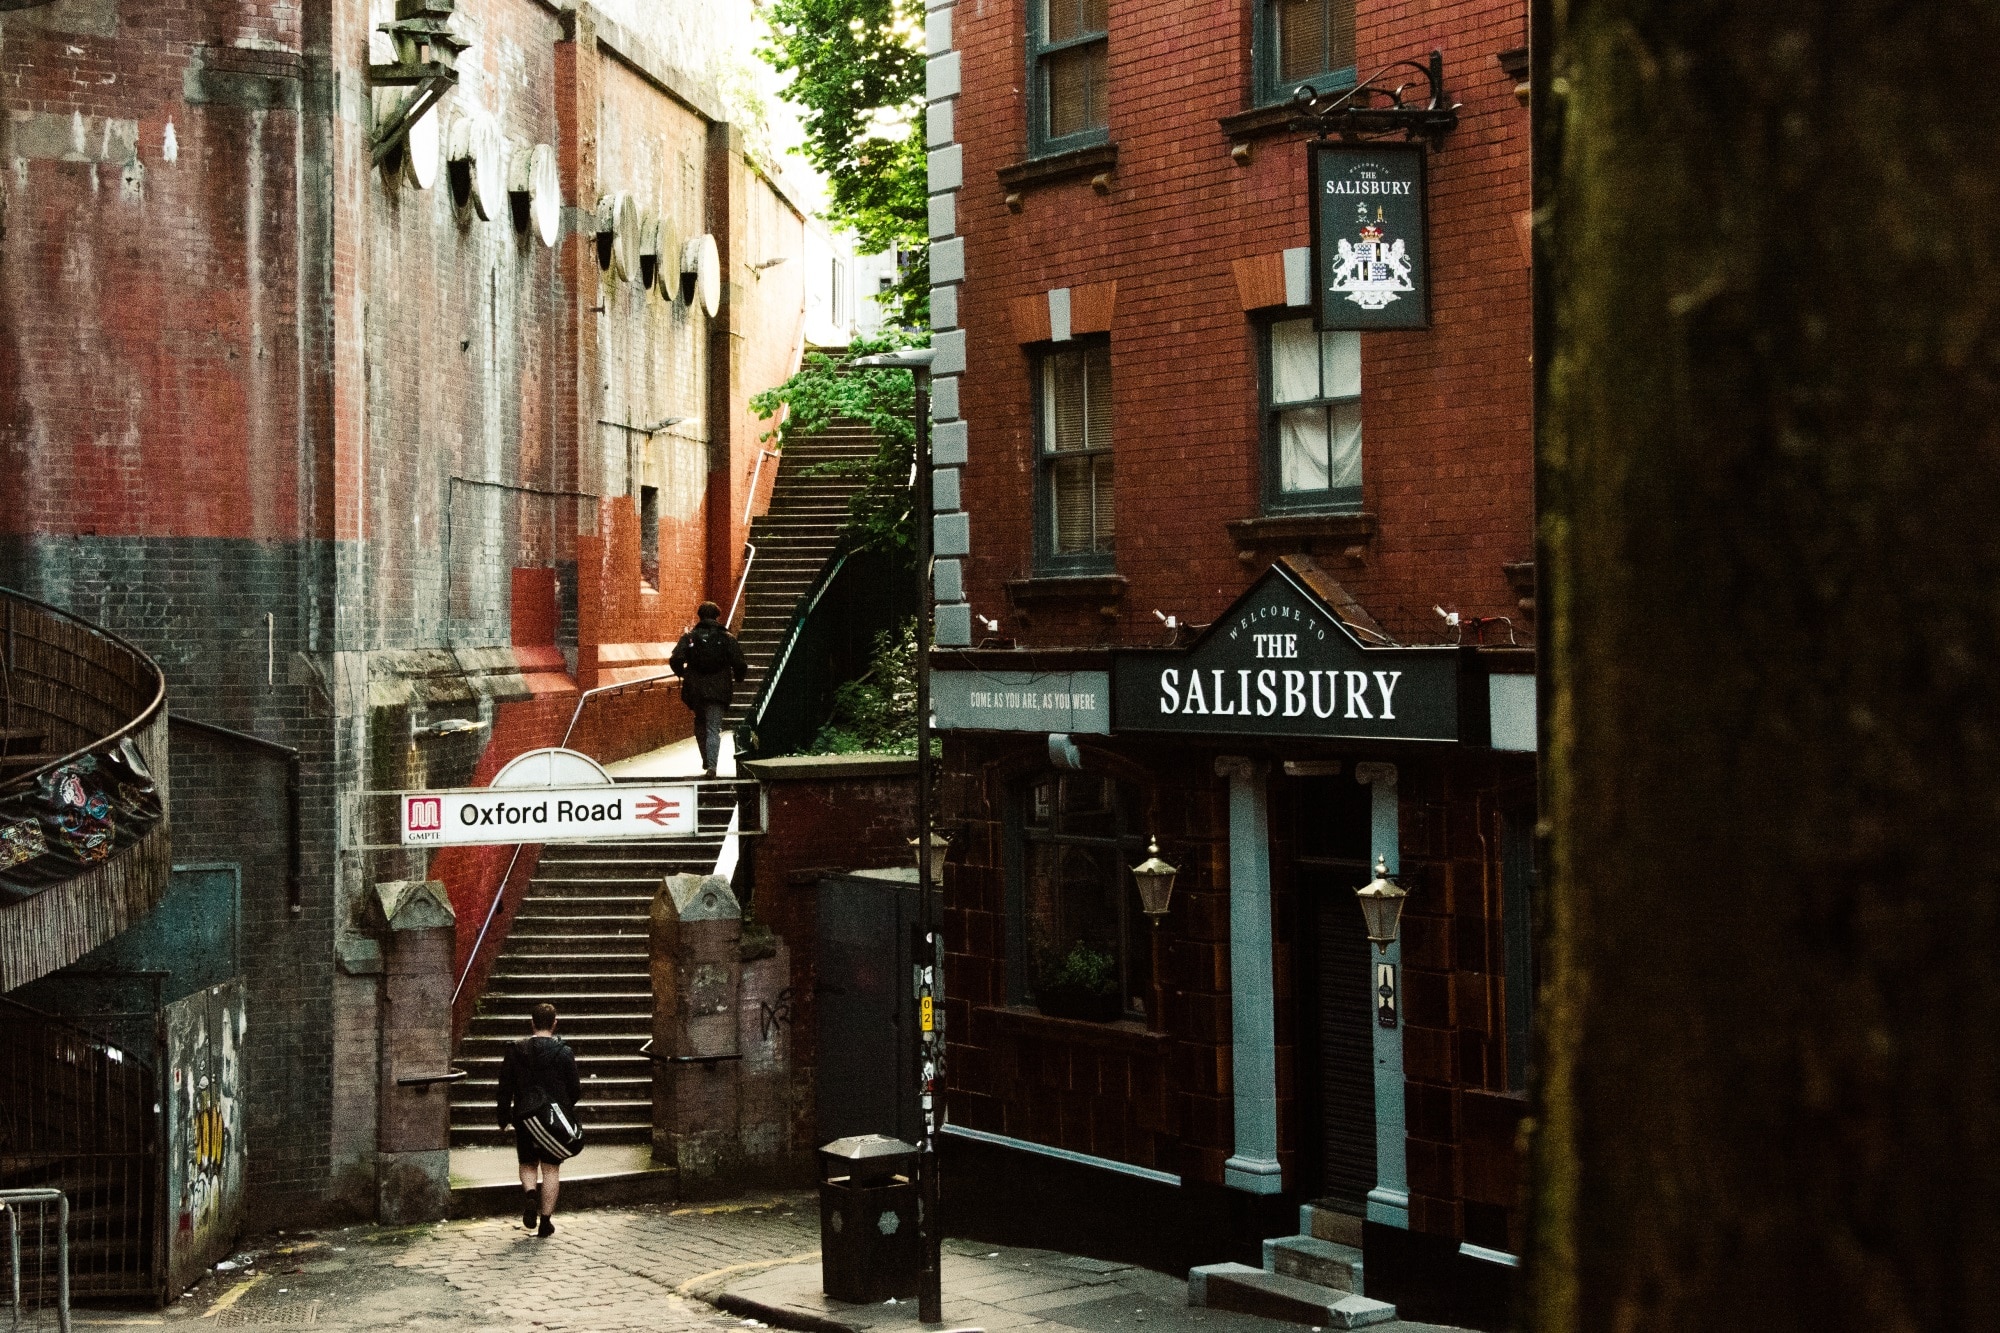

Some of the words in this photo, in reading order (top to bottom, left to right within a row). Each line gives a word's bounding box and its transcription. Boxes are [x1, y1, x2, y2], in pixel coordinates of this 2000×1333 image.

[1326, 180, 1411, 195] SALISBURY
[1360, 171, 1377, 179] THE
[1229, 605, 1301, 641] WELCOME
[1308, 619, 1325, 640] TO
[1252, 633, 1298, 659] THE
[970, 692, 992, 708] COME
[994, 692, 1003, 709] AS
[1005, 692, 1020, 709] YOU
[1022, 693, 1040, 711] ARE,
[1043, 693, 1053, 709] AS
[1055, 693, 1070, 710] YOU
[1072, 693, 1095, 710] WERE
[1160, 668, 1402, 720] SALISBURY
[460, 801, 548, 826] Oxford
[557, 798, 622, 823] Road
